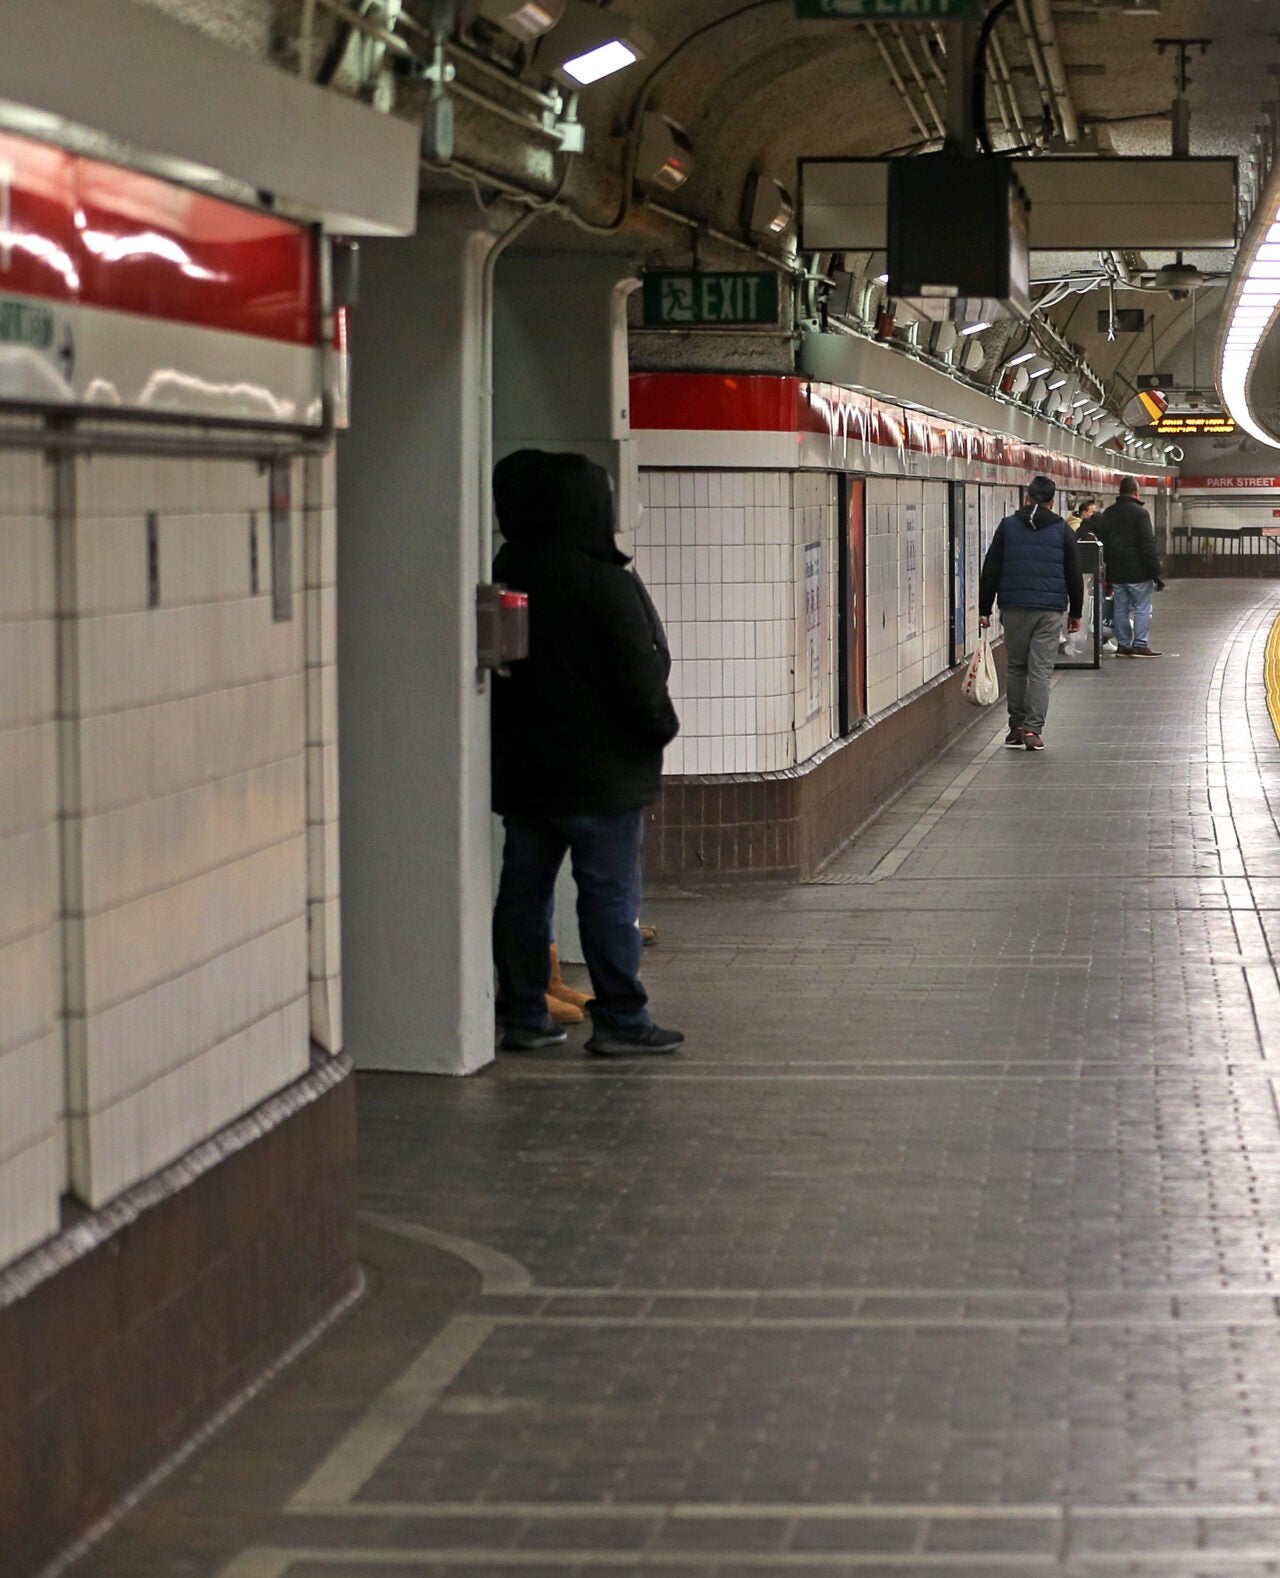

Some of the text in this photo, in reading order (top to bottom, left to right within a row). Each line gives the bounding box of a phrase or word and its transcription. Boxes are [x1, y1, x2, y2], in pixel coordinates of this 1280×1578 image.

[702, 277, 761, 320] EXIT
[1207, 477, 1276, 487] PARK STREET
